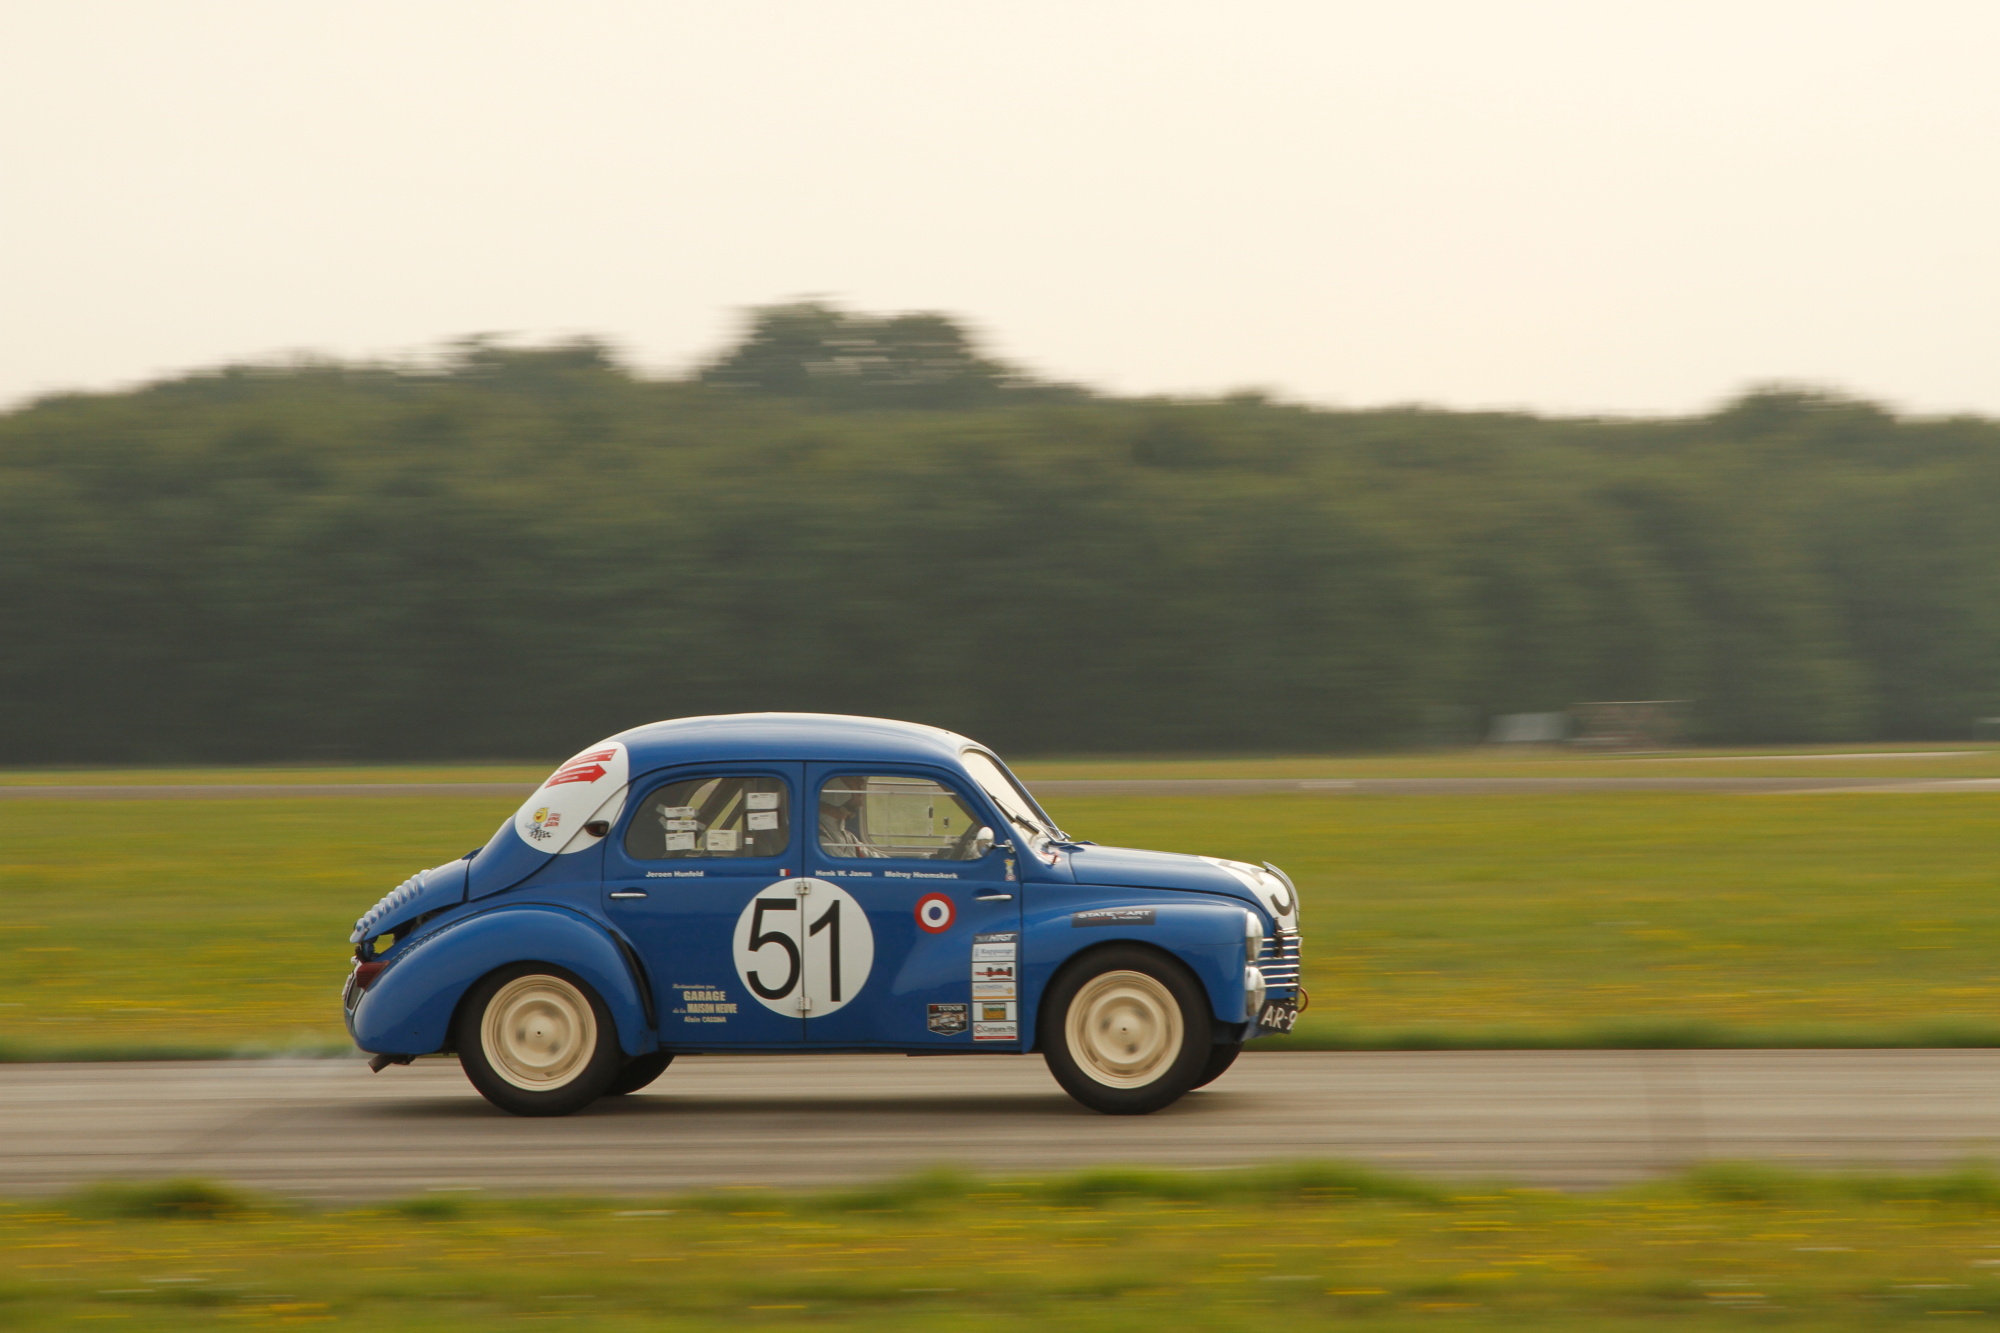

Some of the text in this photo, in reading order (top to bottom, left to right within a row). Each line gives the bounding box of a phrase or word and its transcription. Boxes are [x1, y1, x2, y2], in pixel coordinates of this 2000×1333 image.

[746, 898, 842, 1003] 51
[683, 991, 726, 1001] GARAGE
[687, 1003, 715, 1013] MAISON
[715, 1003, 738, 1013] NEUVE
[1260, 1005, 1298, 1031] AR-9
